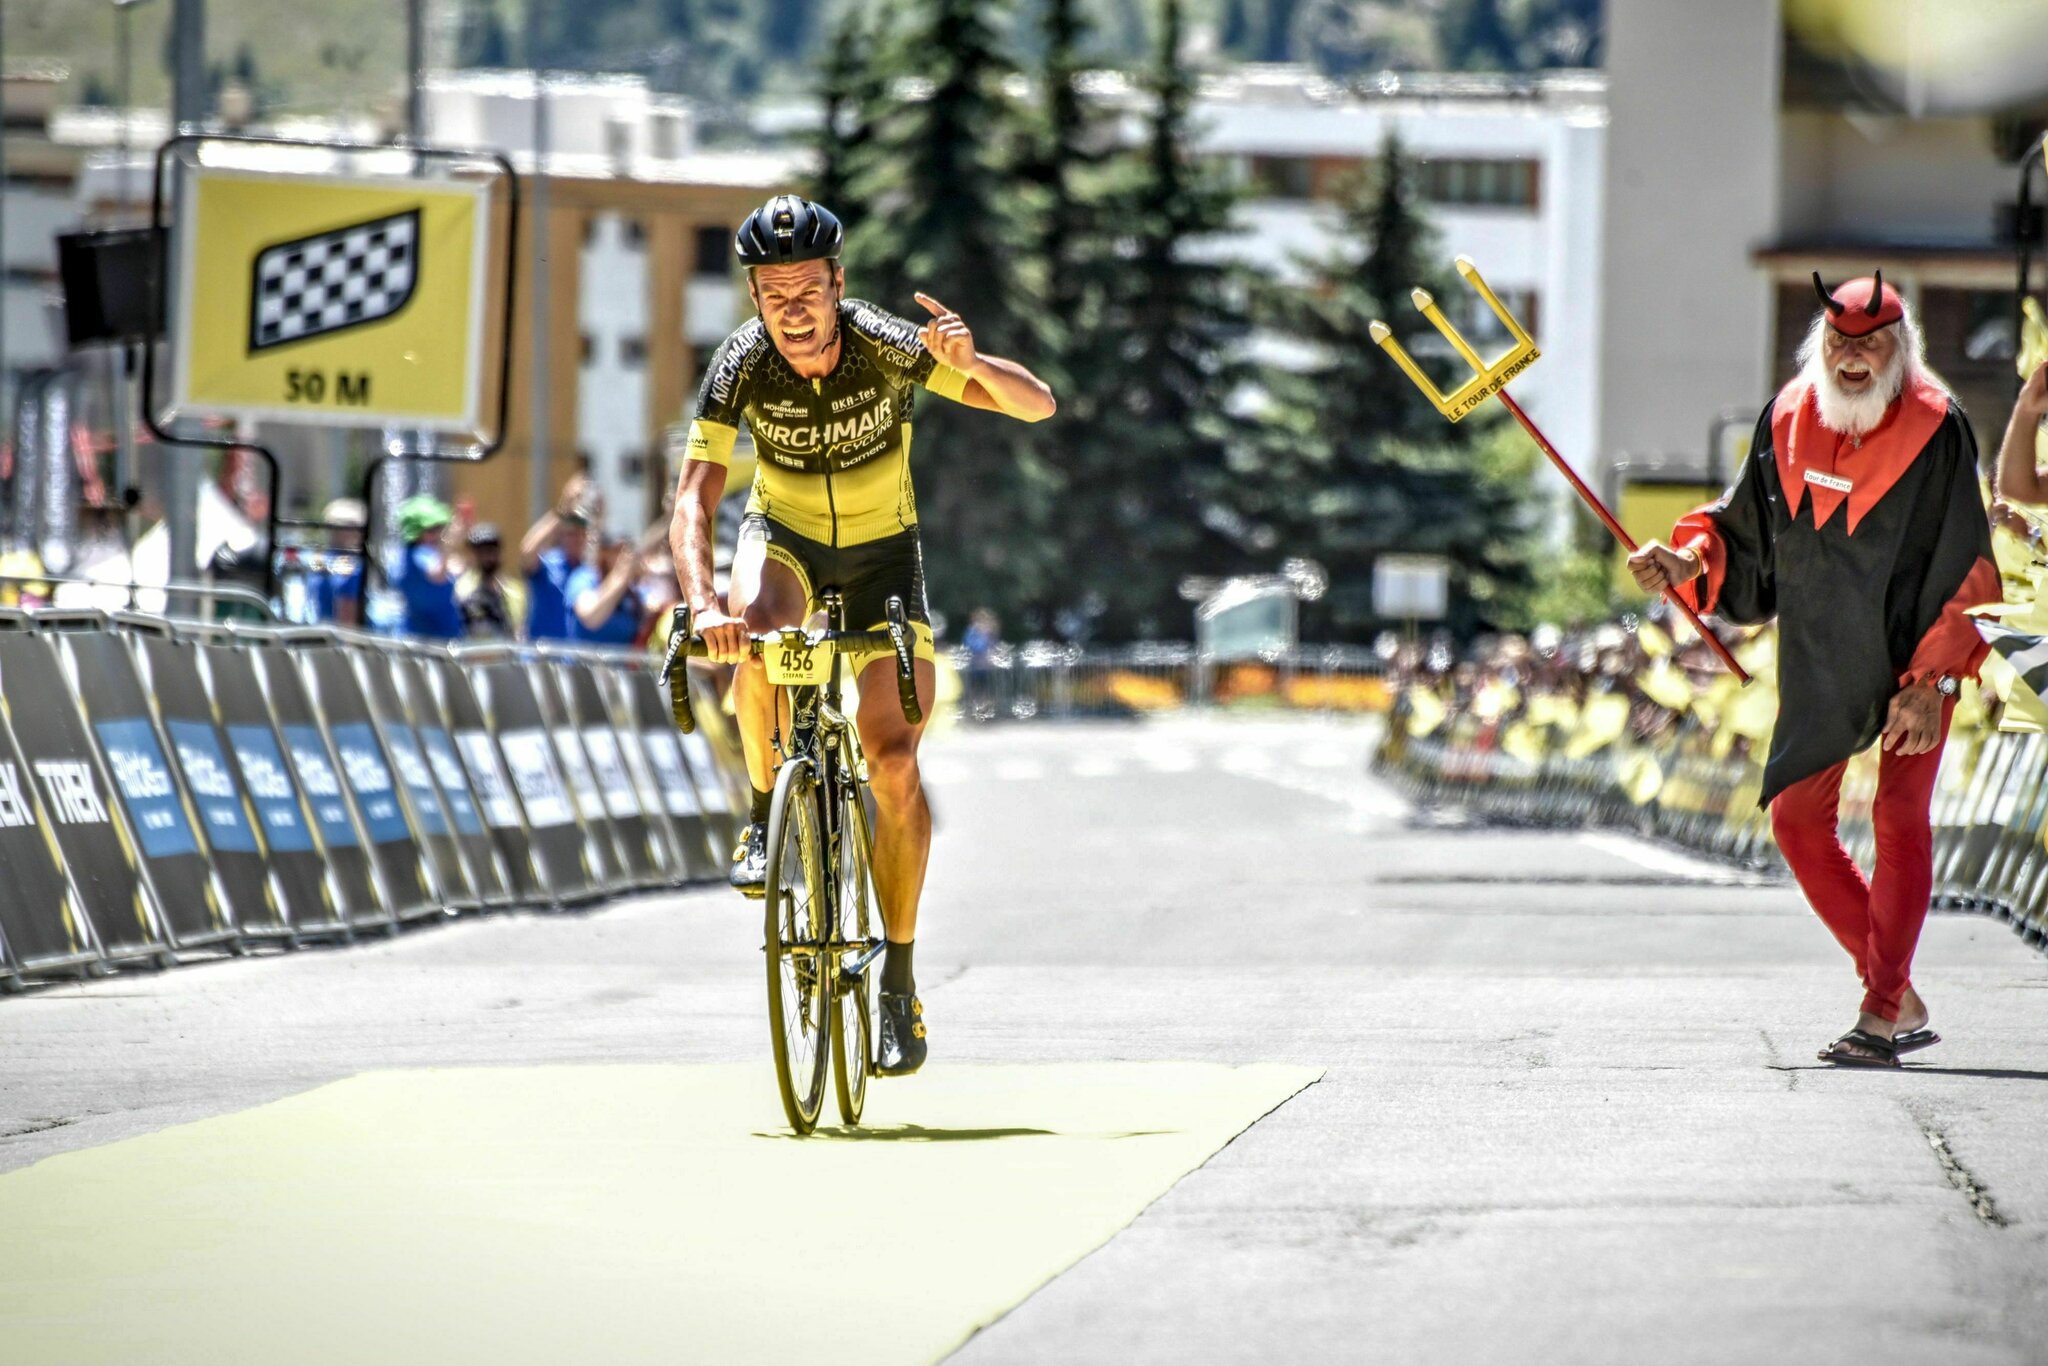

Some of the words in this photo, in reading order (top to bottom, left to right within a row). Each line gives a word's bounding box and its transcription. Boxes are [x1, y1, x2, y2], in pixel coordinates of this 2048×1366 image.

[710, 325, 763, 405] KIRCHMAIR
[746, 339, 769, 371] CYCLING
[285, 369, 325, 404] 50
[336, 372, 371, 407] M
[1448, 407, 1463, 421] LE
[1461, 388, 1490, 410] TOUR
[1489, 376, 1505, 393] DE
[1503, 348, 1541, 380] FRANCE
[756, 397, 892, 448] KIRCHMAIR
[763, 402, 808, 414] MOHRMANN
[842, 419, 893, 454] CYCLING
[840, 441, 887, 469] bamero
[1806, 472, 1820, 481] Tour
[1829, 479, 1851, 490] France
[780, 650, 814, 671] 456
[33, 759, 110, 824] TREK
